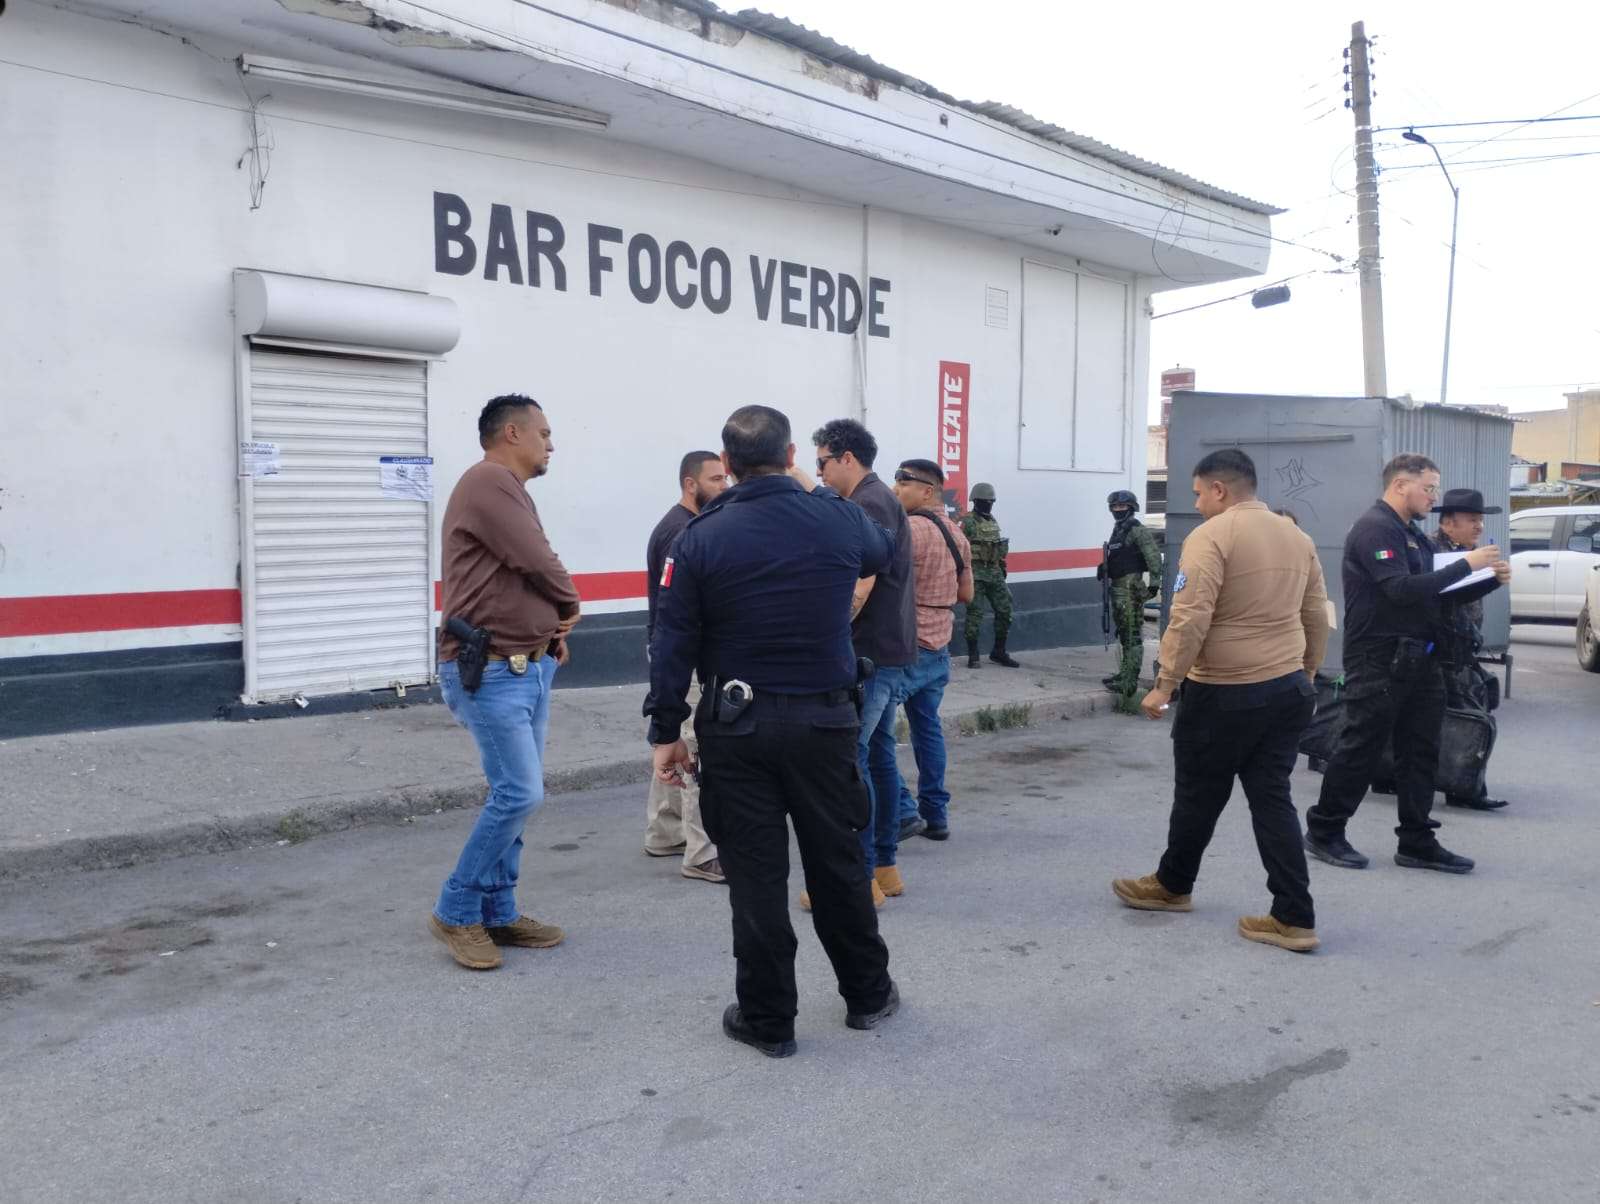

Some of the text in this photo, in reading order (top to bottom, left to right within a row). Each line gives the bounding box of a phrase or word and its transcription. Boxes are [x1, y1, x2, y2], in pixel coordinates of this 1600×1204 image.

[433, 191, 891, 338] BAR FOCO VERDE
[942, 371, 963, 481] TECATE
